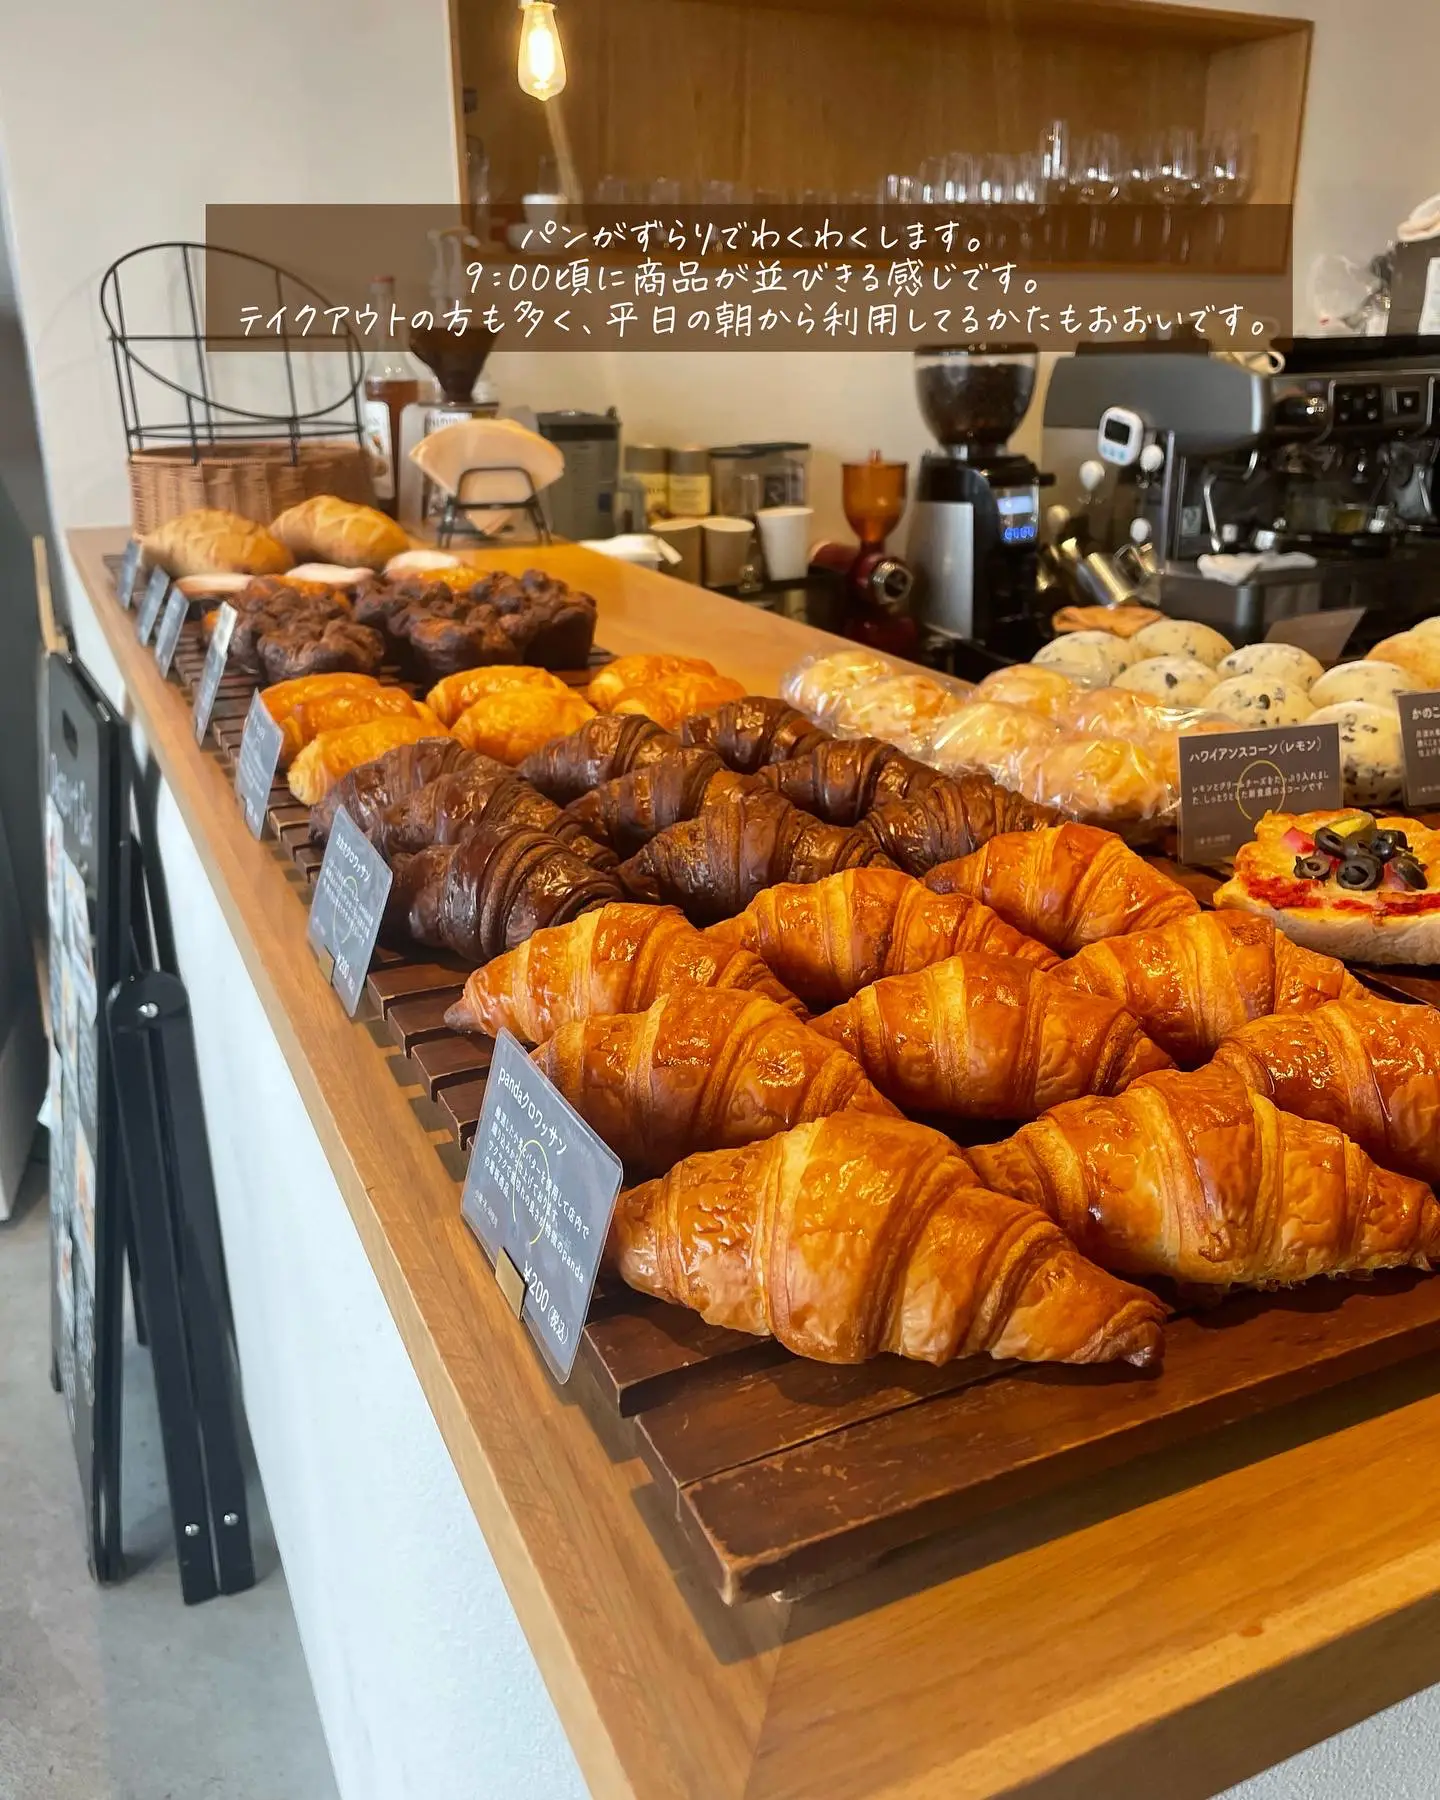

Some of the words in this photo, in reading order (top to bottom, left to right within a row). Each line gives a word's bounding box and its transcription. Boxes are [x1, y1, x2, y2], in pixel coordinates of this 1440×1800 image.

[498, 1067, 567, 1155] pandaクロワッサン
[523, 1259, 550, 1312] ¥200
